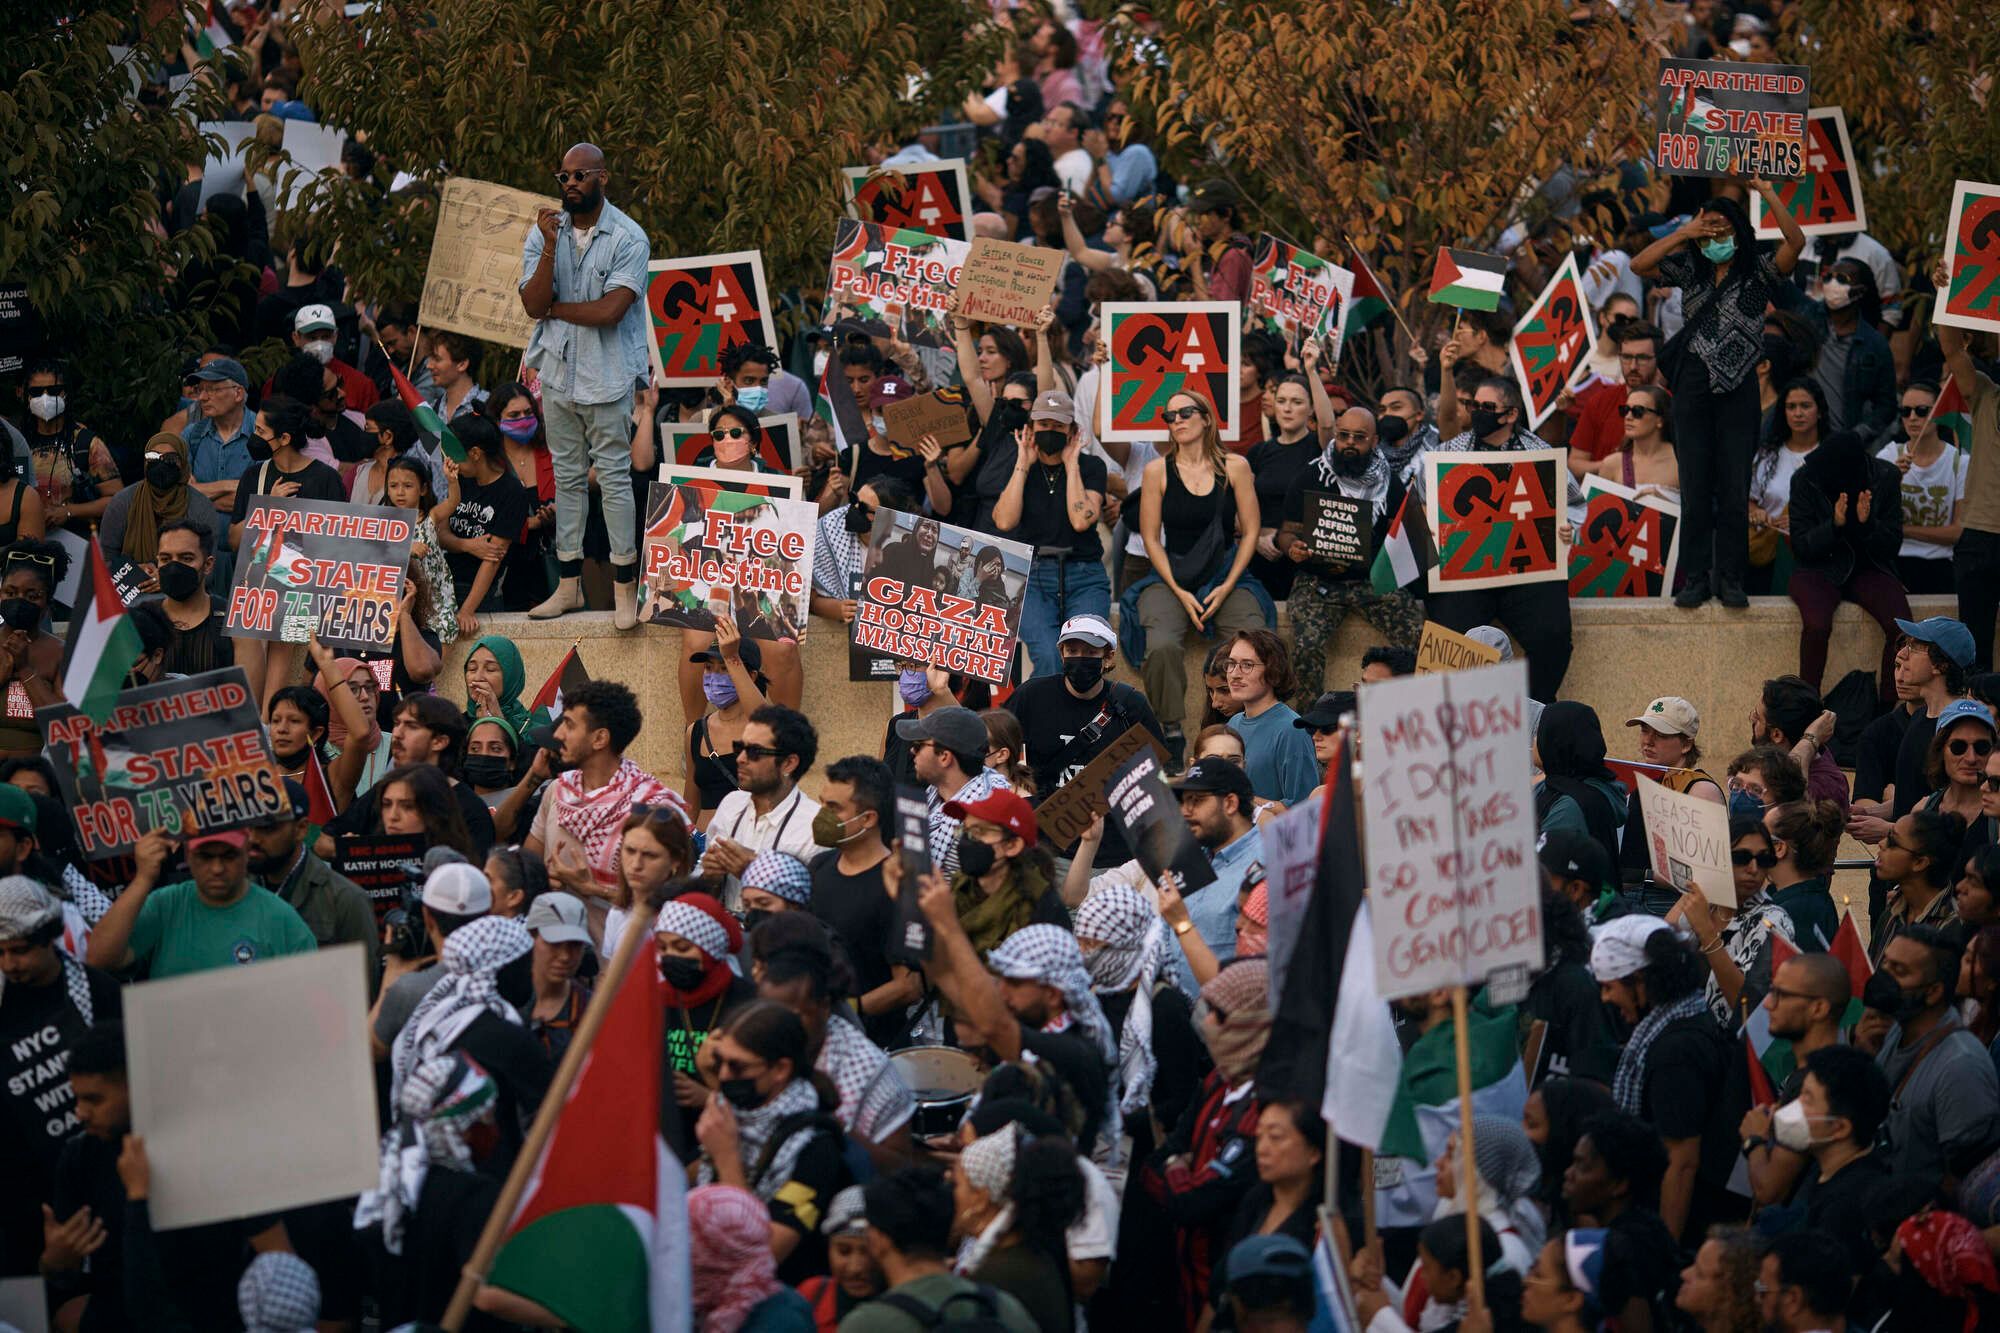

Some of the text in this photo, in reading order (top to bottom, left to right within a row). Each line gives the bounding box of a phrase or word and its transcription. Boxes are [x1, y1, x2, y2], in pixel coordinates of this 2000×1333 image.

[1660, 68, 1805, 94] APARTHEID
[1705, 108, 1803, 136] STATE
[1657, 132, 1801, 176] FOR 75 YEARS
[881, 242, 961, 288] Free
[833, 265, 949, 311] Palestin
[882, 382, 897, 395] H
[1319, 499, 1359, 513] DEFEND
[1323, 509, 1353, 523] GAZA
[246, 507, 410, 543] APARTHEID
[702, 509, 806, 560] Free
[1312, 528, 1360, 545] AL-AQSA
[1318, 518, 1357, 534] DEFEND
[1316, 540, 1356, 553] DEFEND
[287, 558, 401, 595] STATE
[647, 543, 804, 597] Palestine
[226, 586, 278, 632] FOR
[283, 590, 314, 617] 75
[317, 593, 394, 644] YEARS
[867, 576, 1010, 636] GAZA
[860, 601, 1009, 659] HOSPITAL
[855, 622, 1006, 682] MASSACRE
[7, 709, 34, 718] STATE
[8, 695, 30, 704] ABOLIS
[1381, 694, 1523, 757] MR BIDEN
[125, 729, 267, 786] STATE
[74, 767, 282, 852] FOR 75 YEARS
[1041, 779, 1087, 818] NOT
[1375, 768, 1400, 819] I
[1652, 794, 1702, 830] CEASE
[1395, 791, 1520, 851] PAY TAXES
[1671, 825, 1729, 868] NOW!
[343, 861, 377, 871] KATHY
[1378, 861, 1418, 898] SO
[368, 887, 399, 898] IDENT
[11, 1025, 60, 1062] NYC
[33, 1080, 76, 1113] WIT
[46, 1111, 80, 1137] GA
